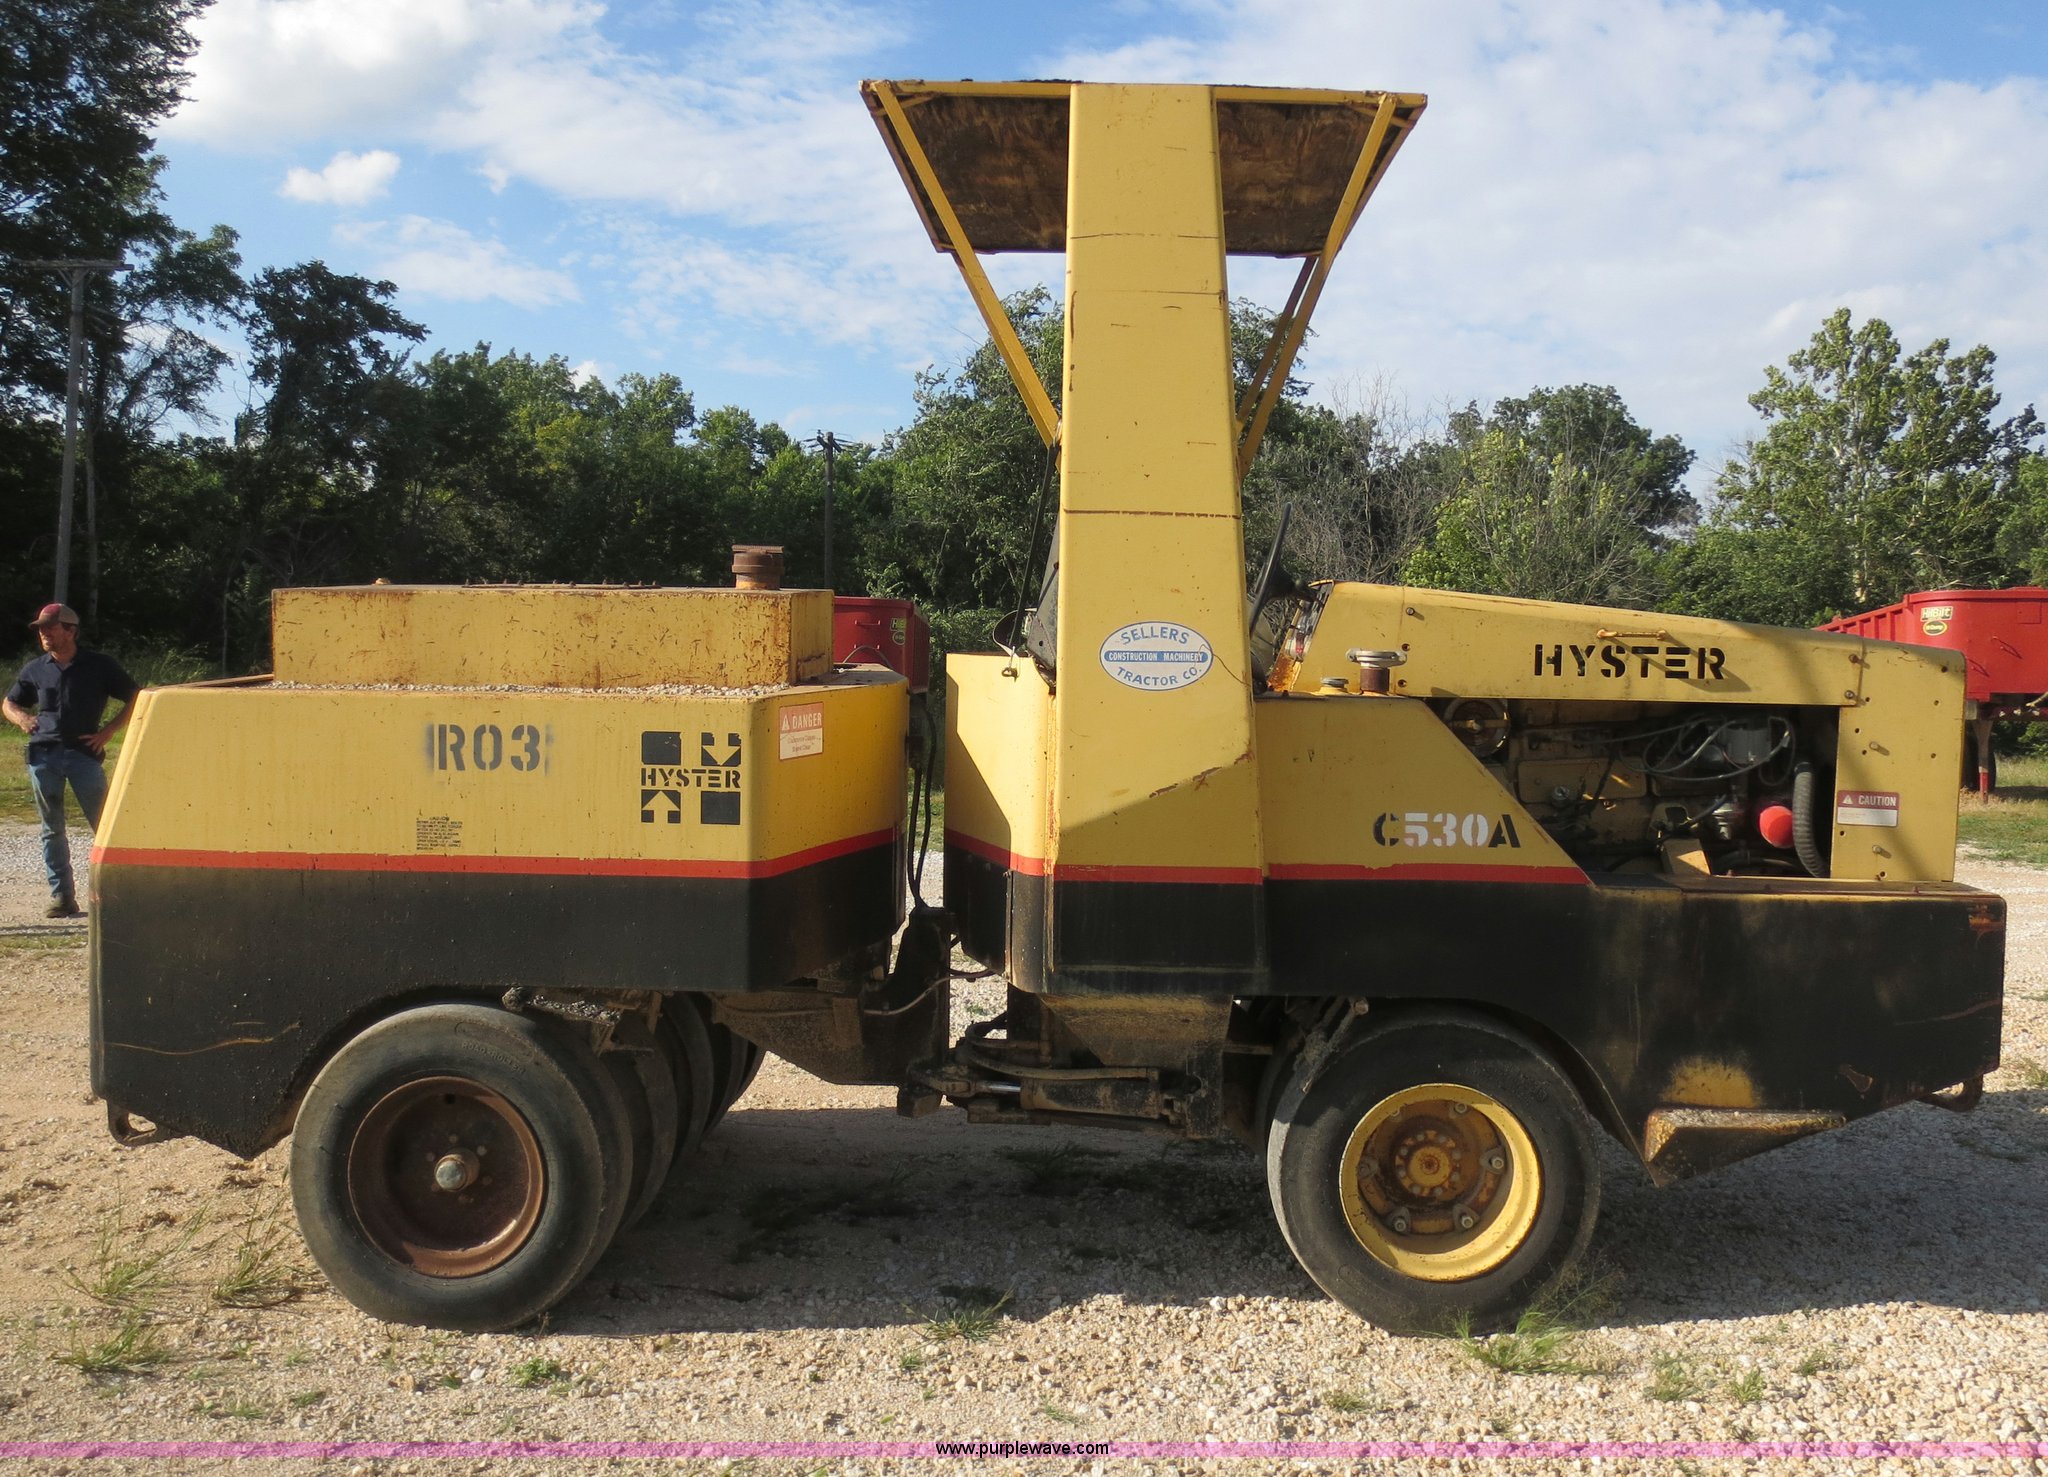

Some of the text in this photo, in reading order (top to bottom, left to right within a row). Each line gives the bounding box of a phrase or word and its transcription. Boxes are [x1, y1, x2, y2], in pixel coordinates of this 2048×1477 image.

[1121, 625, 1190, 645] SELLERS
[1108, 651, 1205, 662] CONSTRUCTION MACHINERY
[1534, 644, 1726, 680] HYSTER
[1117, 666, 1202, 687] TRACTOR CO.
[792, 712, 822, 729] DANGER
[641, 768, 741, 788] HYSTER
[1858, 795, 1897, 807] CAUTION
[1373, 812, 1521, 848] C530A
